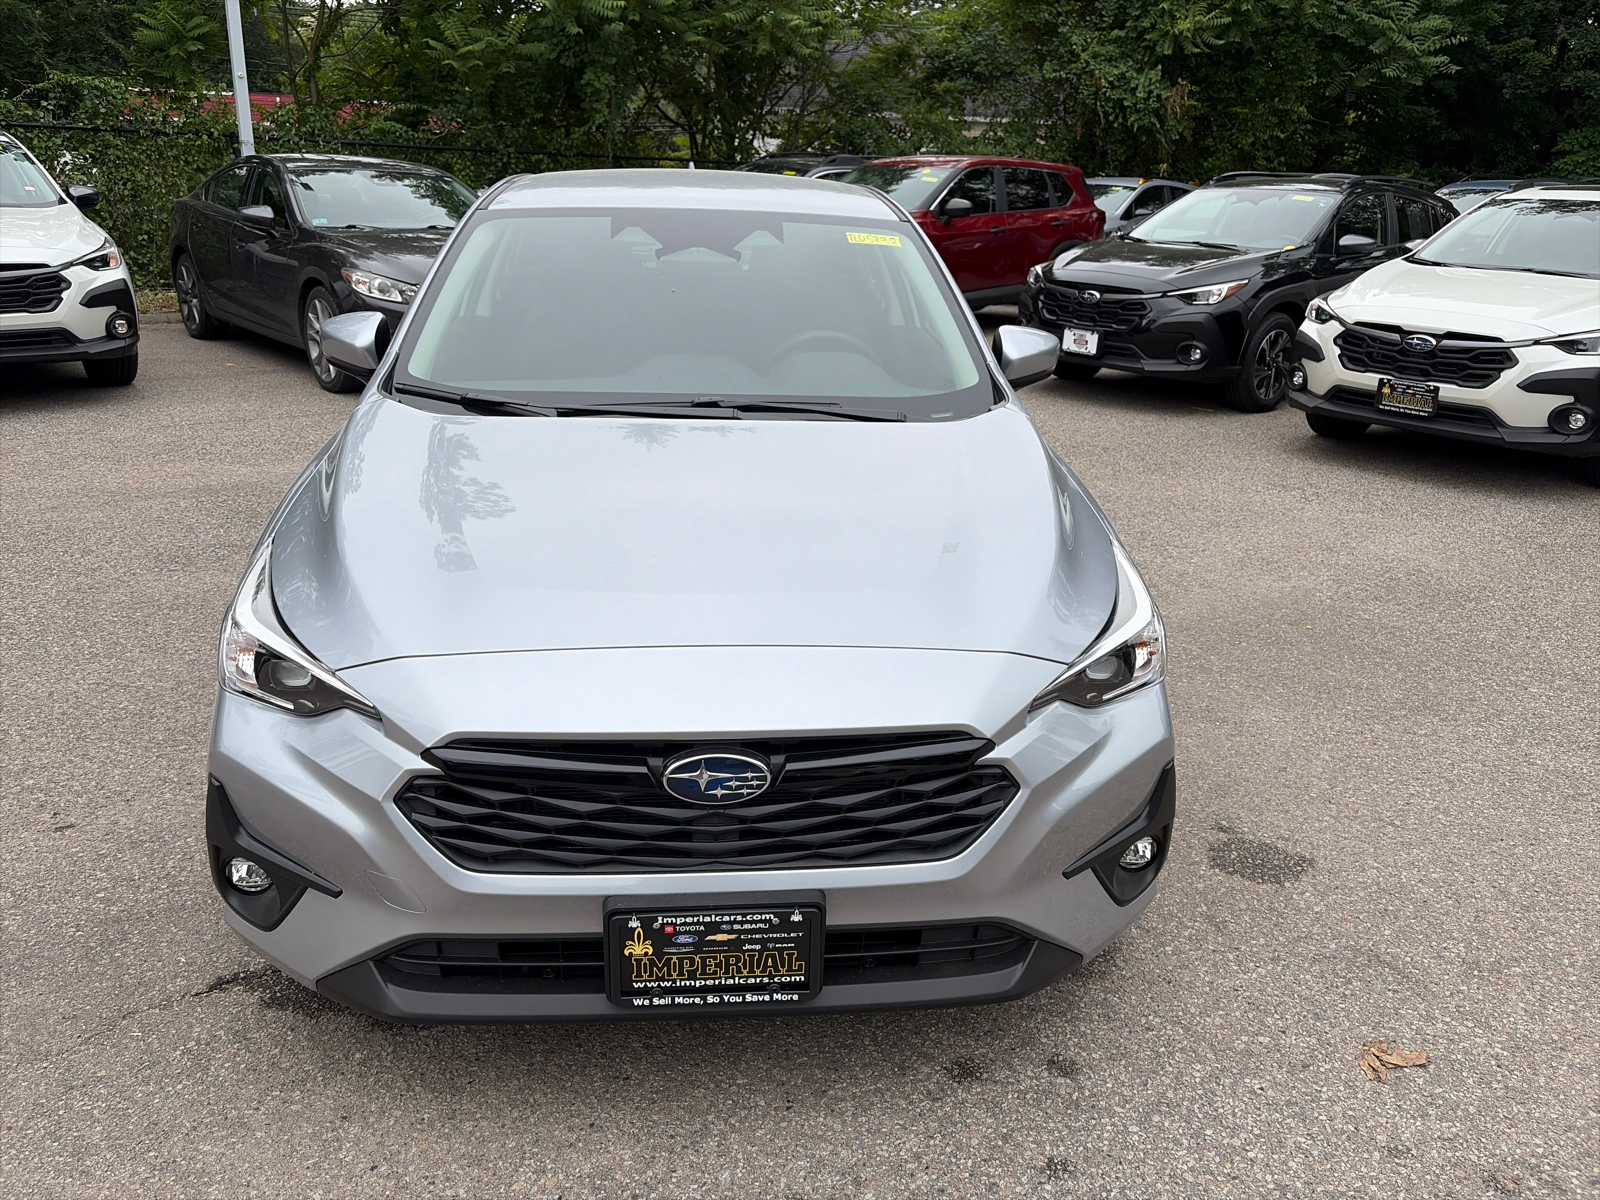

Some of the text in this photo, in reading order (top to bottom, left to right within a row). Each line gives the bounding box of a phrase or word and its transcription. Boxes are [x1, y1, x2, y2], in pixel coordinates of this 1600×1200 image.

[657, 913, 774, 924] Imperialcars.com
[732, 922, 769, 930] SUBARU
[742, 943, 762, 951] Jeep
[632, 950, 805, 981] IMPERIAL
[632, 975, 805, 988] www.imperialcars.com
[633, 993, 799, 1006] We Sell More, So You Save More
